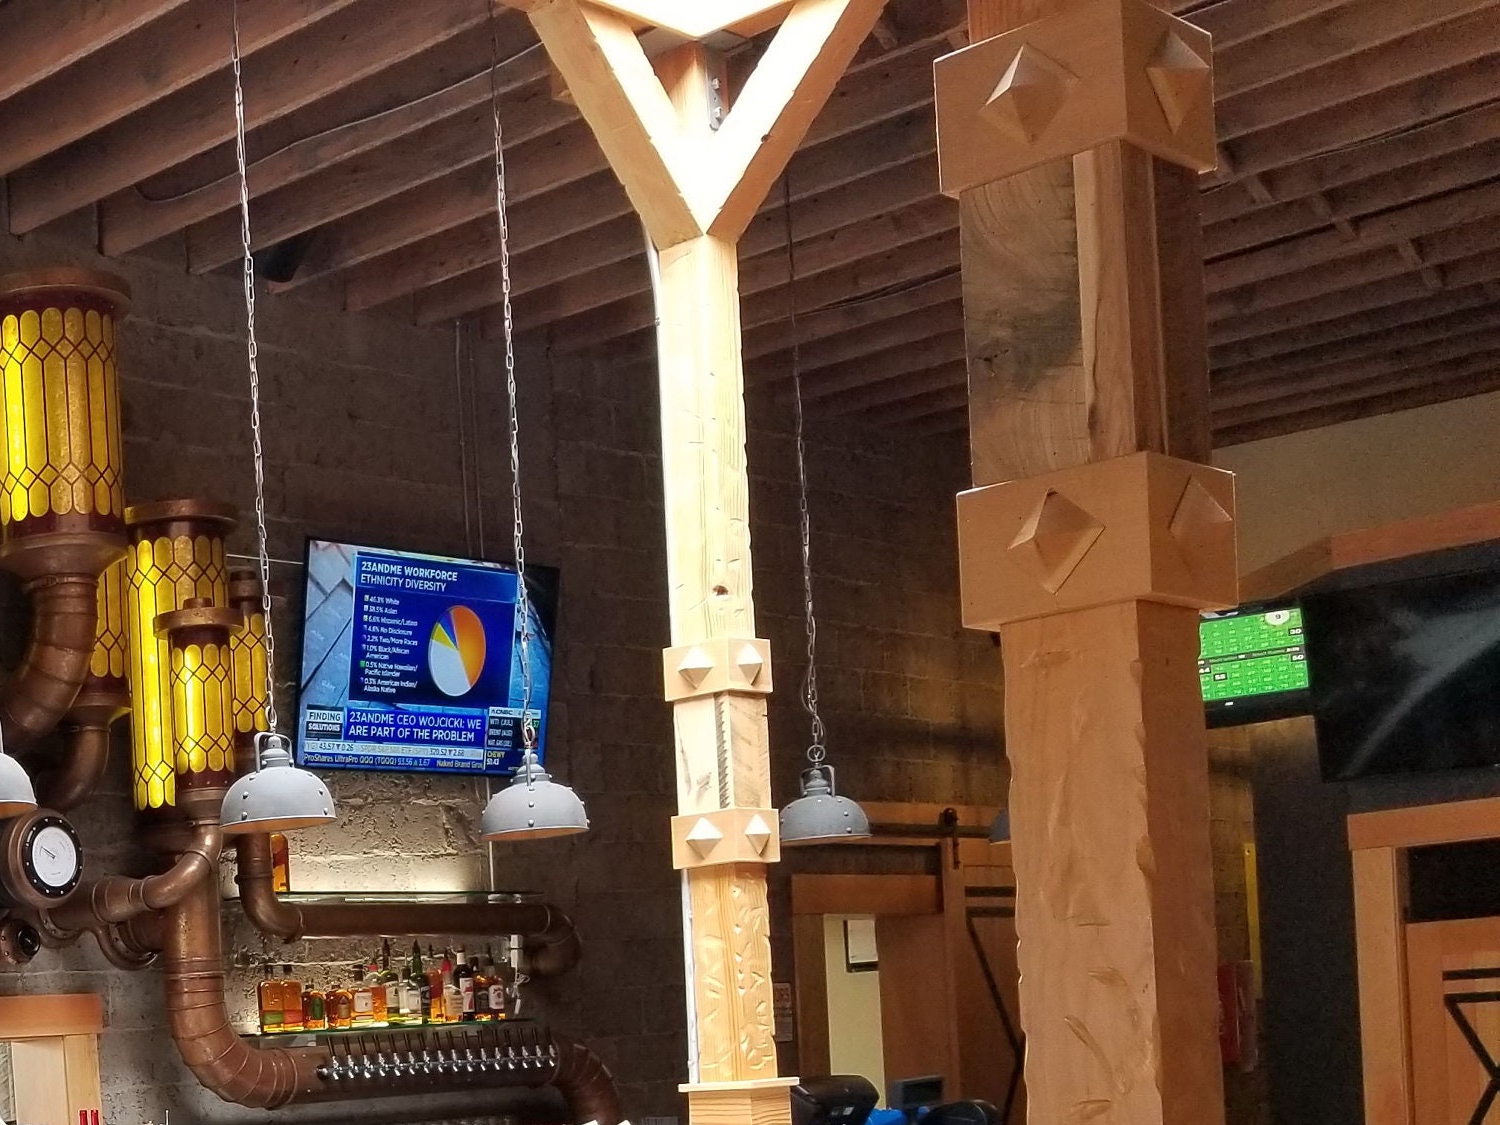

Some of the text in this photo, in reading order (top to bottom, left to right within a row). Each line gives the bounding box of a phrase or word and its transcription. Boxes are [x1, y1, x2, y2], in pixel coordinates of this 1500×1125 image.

[362, 561, 458, 581] 23ANDME WORKFORCE
[361, 573, 446, 592] ETHNICITY DIVERSITY
[310, 712, 340, 721] FINDING
[350, 712, 481, 729] 23ANDME CEO WOJCICKI: WE
[308, 723, 340, 731] SOLUTIONS
[349, 726, 474, 742] ARE PART OF THE PROBLEM
